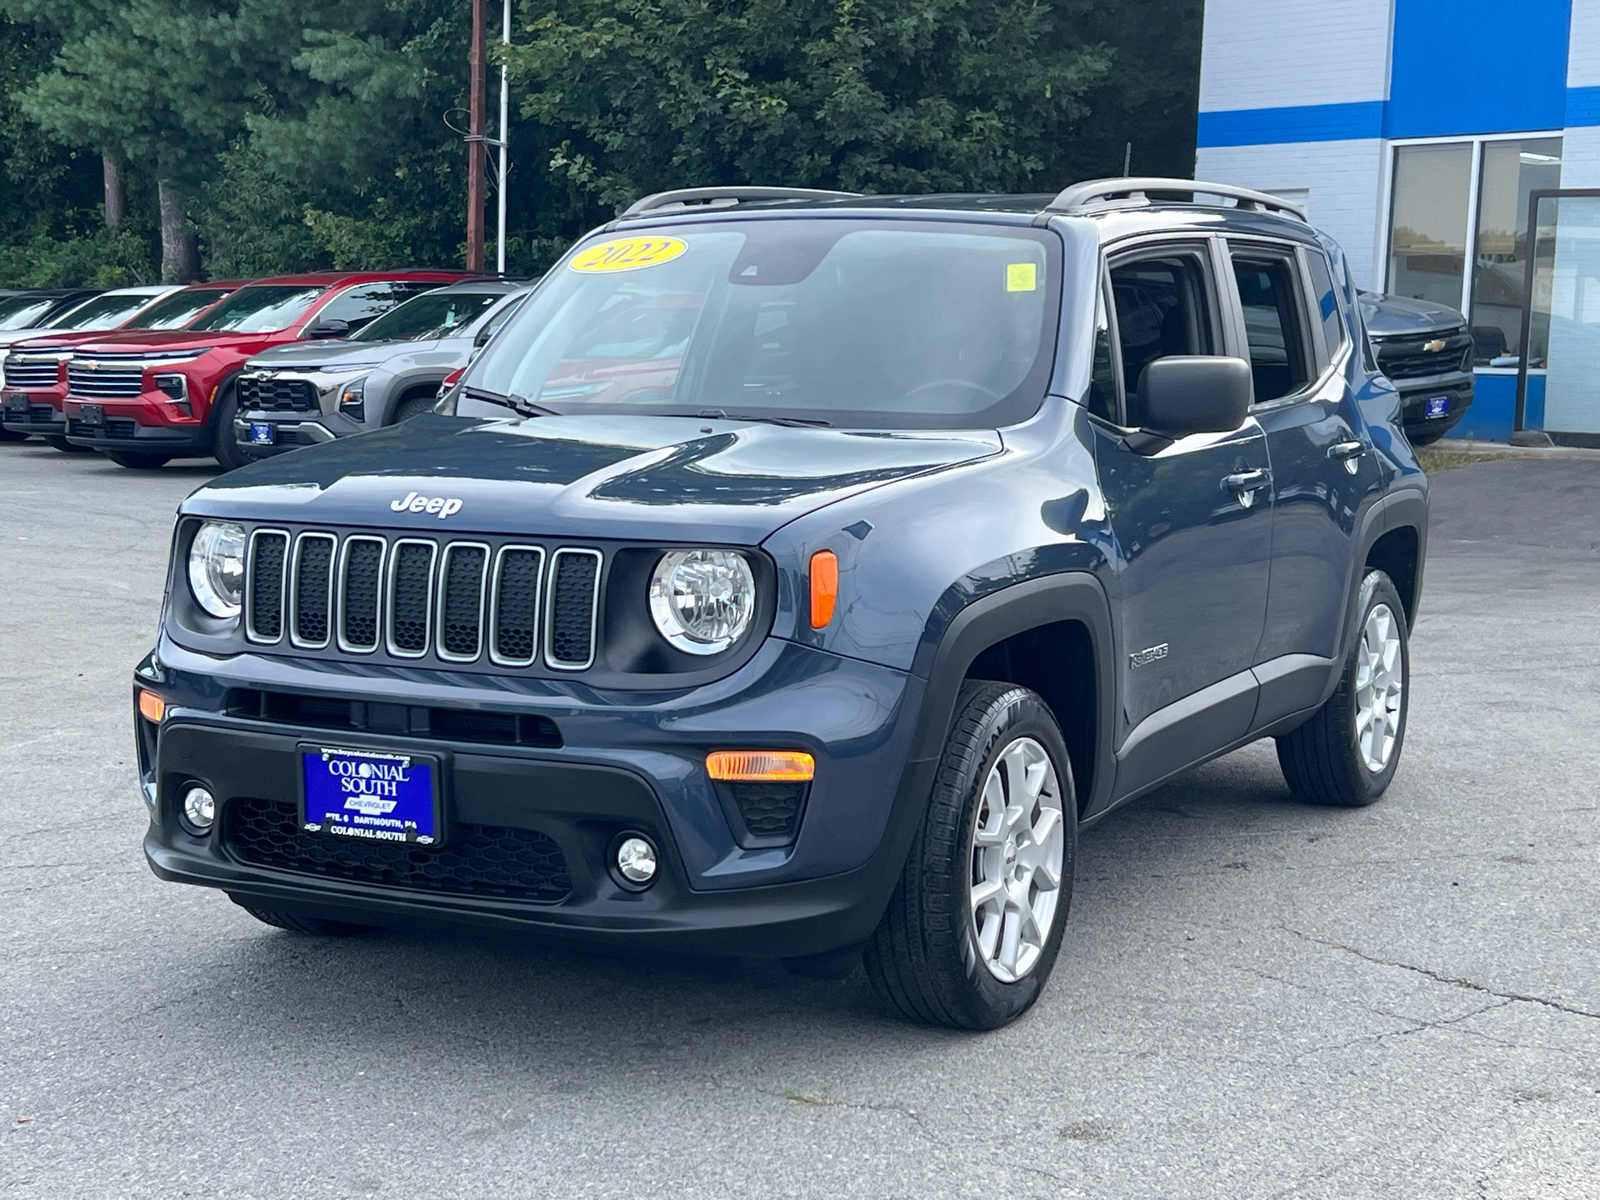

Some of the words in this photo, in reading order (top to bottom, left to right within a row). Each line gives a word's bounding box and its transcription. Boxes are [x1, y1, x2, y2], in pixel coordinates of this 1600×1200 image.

[582, 241, 671, 267] 2022
[390, 491, 464, 520] Jeep
[328, 759, 410, 782] COLONIAL
[341, 777, 398, 797] SOUTH
[348, 799, 392, 811] CHEVROLET
[343, 814, 349, 823] 6
[354, 815, 403, 829] DARTMOUTH,
[330, 825, 376, 838] COLONIAL
[375, 832, 406, 842] SOUTH
